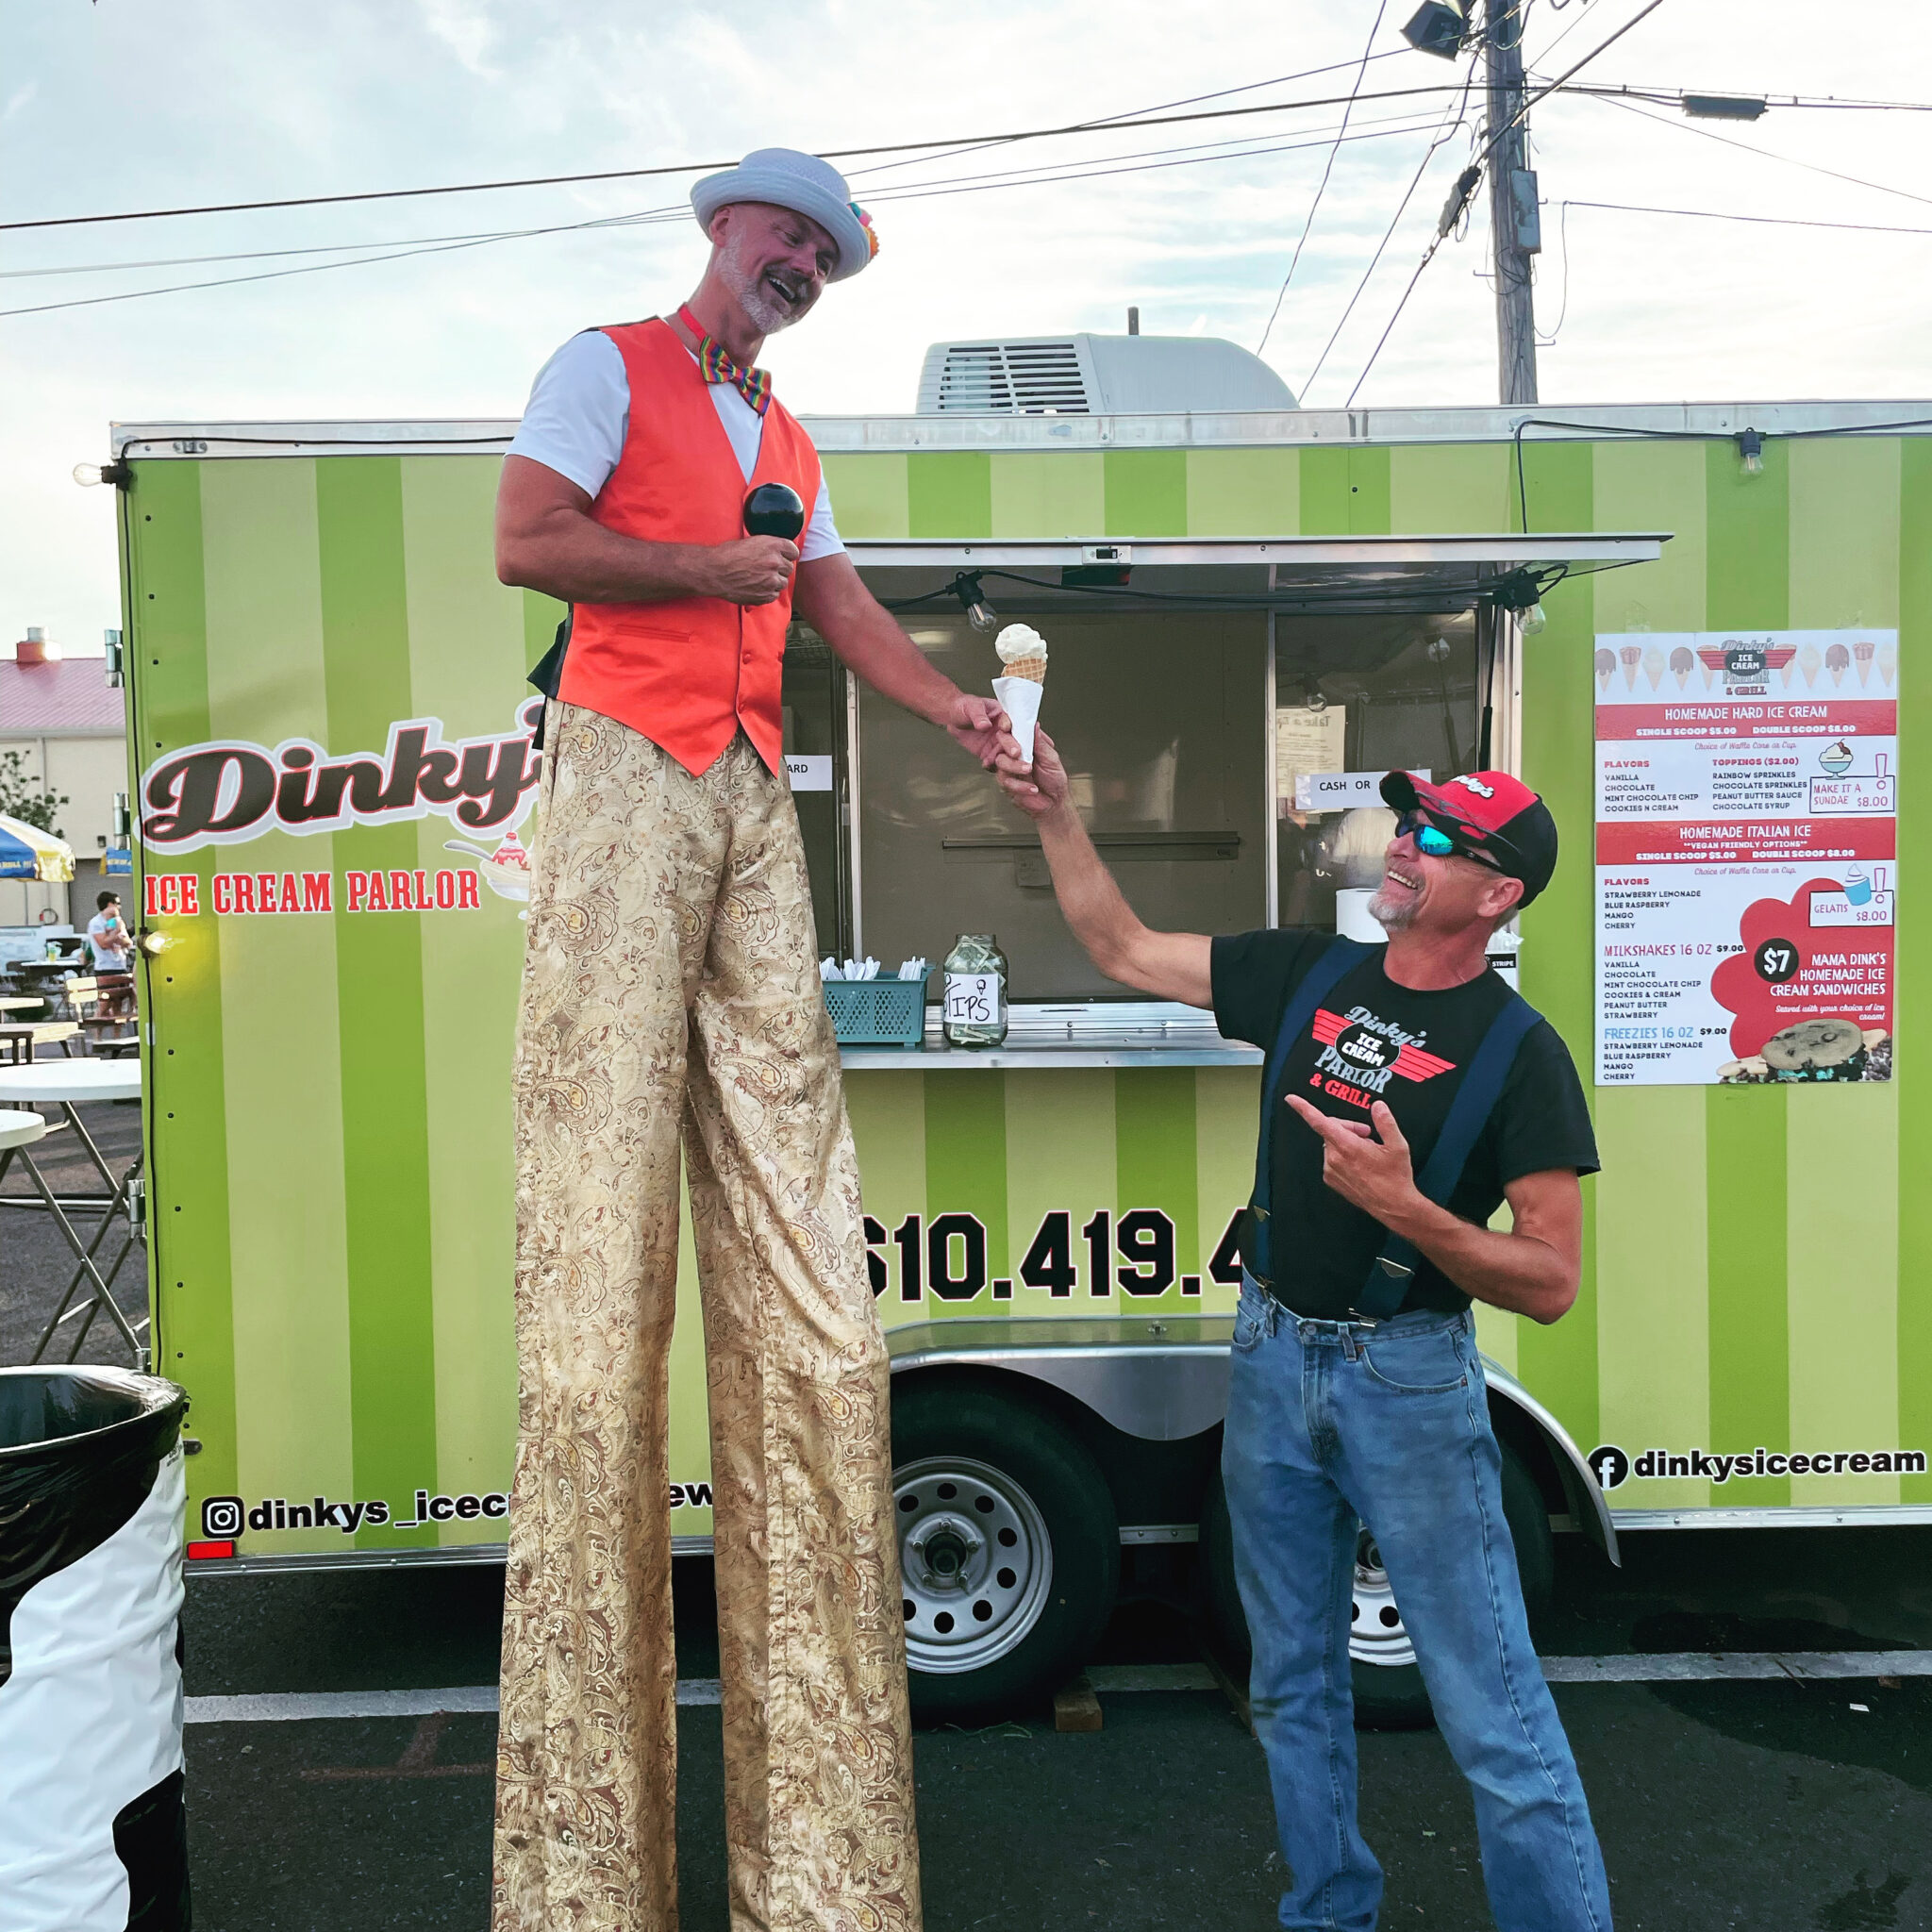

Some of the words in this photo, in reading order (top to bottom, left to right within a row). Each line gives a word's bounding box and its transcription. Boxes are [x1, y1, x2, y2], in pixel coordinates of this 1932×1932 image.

[1738, 654, 1753, 662] ICE
[1664, 708, 1729, 721] HOMEMADE
[1732, 707, 1763, 719] HARD
[1767, 706, 1785, 718] ICE
[1788, 705, 1827, 718] CREAM
[1636, 728, 1673, 737] SINGLE
[1673, 727, 1707, 736] SCOOP
[1752, 725, 1790, 734] DOUBLE
[1792, 724, 1826, 734] SCOOP
[1712, 758, 1762, 766] TOPPINGS
[1764, 757, 1799, 766] ($2.00)
[787, 764, 808, 774] ARD
[1319, 781, 1347, 791] CASH
[1355, 780, 1371, 790] OR
[1813, 784, 1840, 793] MAKE
[1841, 784, 1852, 792] IT
[1855, 783, 1861, 792] A
[1813, 796, 1849, 805] SUNDAE
[1857, 796, 1889, 807] $8.00
[1679, 825, 1743, 839] HOMEMADE
[1747, 824, 1790, 838] ITALIAN
[1793, 824, 1812, 837] ICE
[1720, 841, 1760, 849] FRIENDLY
[1673, 852, 1707, 860] SCOOP
[1752, 850, 1790, 858] DOUBLE
[1791, 849, 1826, 858] SCOOP
[1694, 867, 1718, 875] Choice
[1719, 866, 1727, 875] of
[1728, 866, 1751, 874] Waffle
[145, 874, 199, 916] ICE
[212, 871, 333, 914] CREAM
[346, 869, 481, 913] PARLOR
[1856, 910, 1887, 922] $8.00
[1604, 944, 1676, 957] MILKSHAKES
[1680, 943, 1692, 956] 16
[1696, 943, 1712, 955] OZ
[1716, 944, 1744, 953] $9.00
[1763, 947, 1790, 975] $7
[1811, 954, 1847, 966] MAMA
[1850, 952, 1887, 965] DINK'S
[1800, 969, 1864, 981] HOMEMADE
[1867, 968, 1886, 980] ICE
[1770, 984, 1809, 996] CREAM
[1812, 983, 1887, 995] SANDWICHES
[943, 983, 991, 1022] TIPS
[1774, 1005, 1801, 1013] Served
[1343, 1006, 1427, 1048] Dinky's
[1604, 1027, 1658, 1040] FREEZIES
[1661, 1026, 1674, 1039] 16
[1678, 1026, 1694, 1038] OZ
[1699, 1027, 1727, 1036] $9.00
[1356, 1032, 1383, 1052] ICE
[1341, 1041, 1386, 1067] CREAM
[1314, 1045, 1393, 1094] PARLOR
[1309, 1073, 1323, 1088] &
[1324, 1079, 1373, 1110] GRILL
[1634, 1447, 1926, 1484] dinkysicecream
[247, 1490, 512, 1534] dinkys_icec
